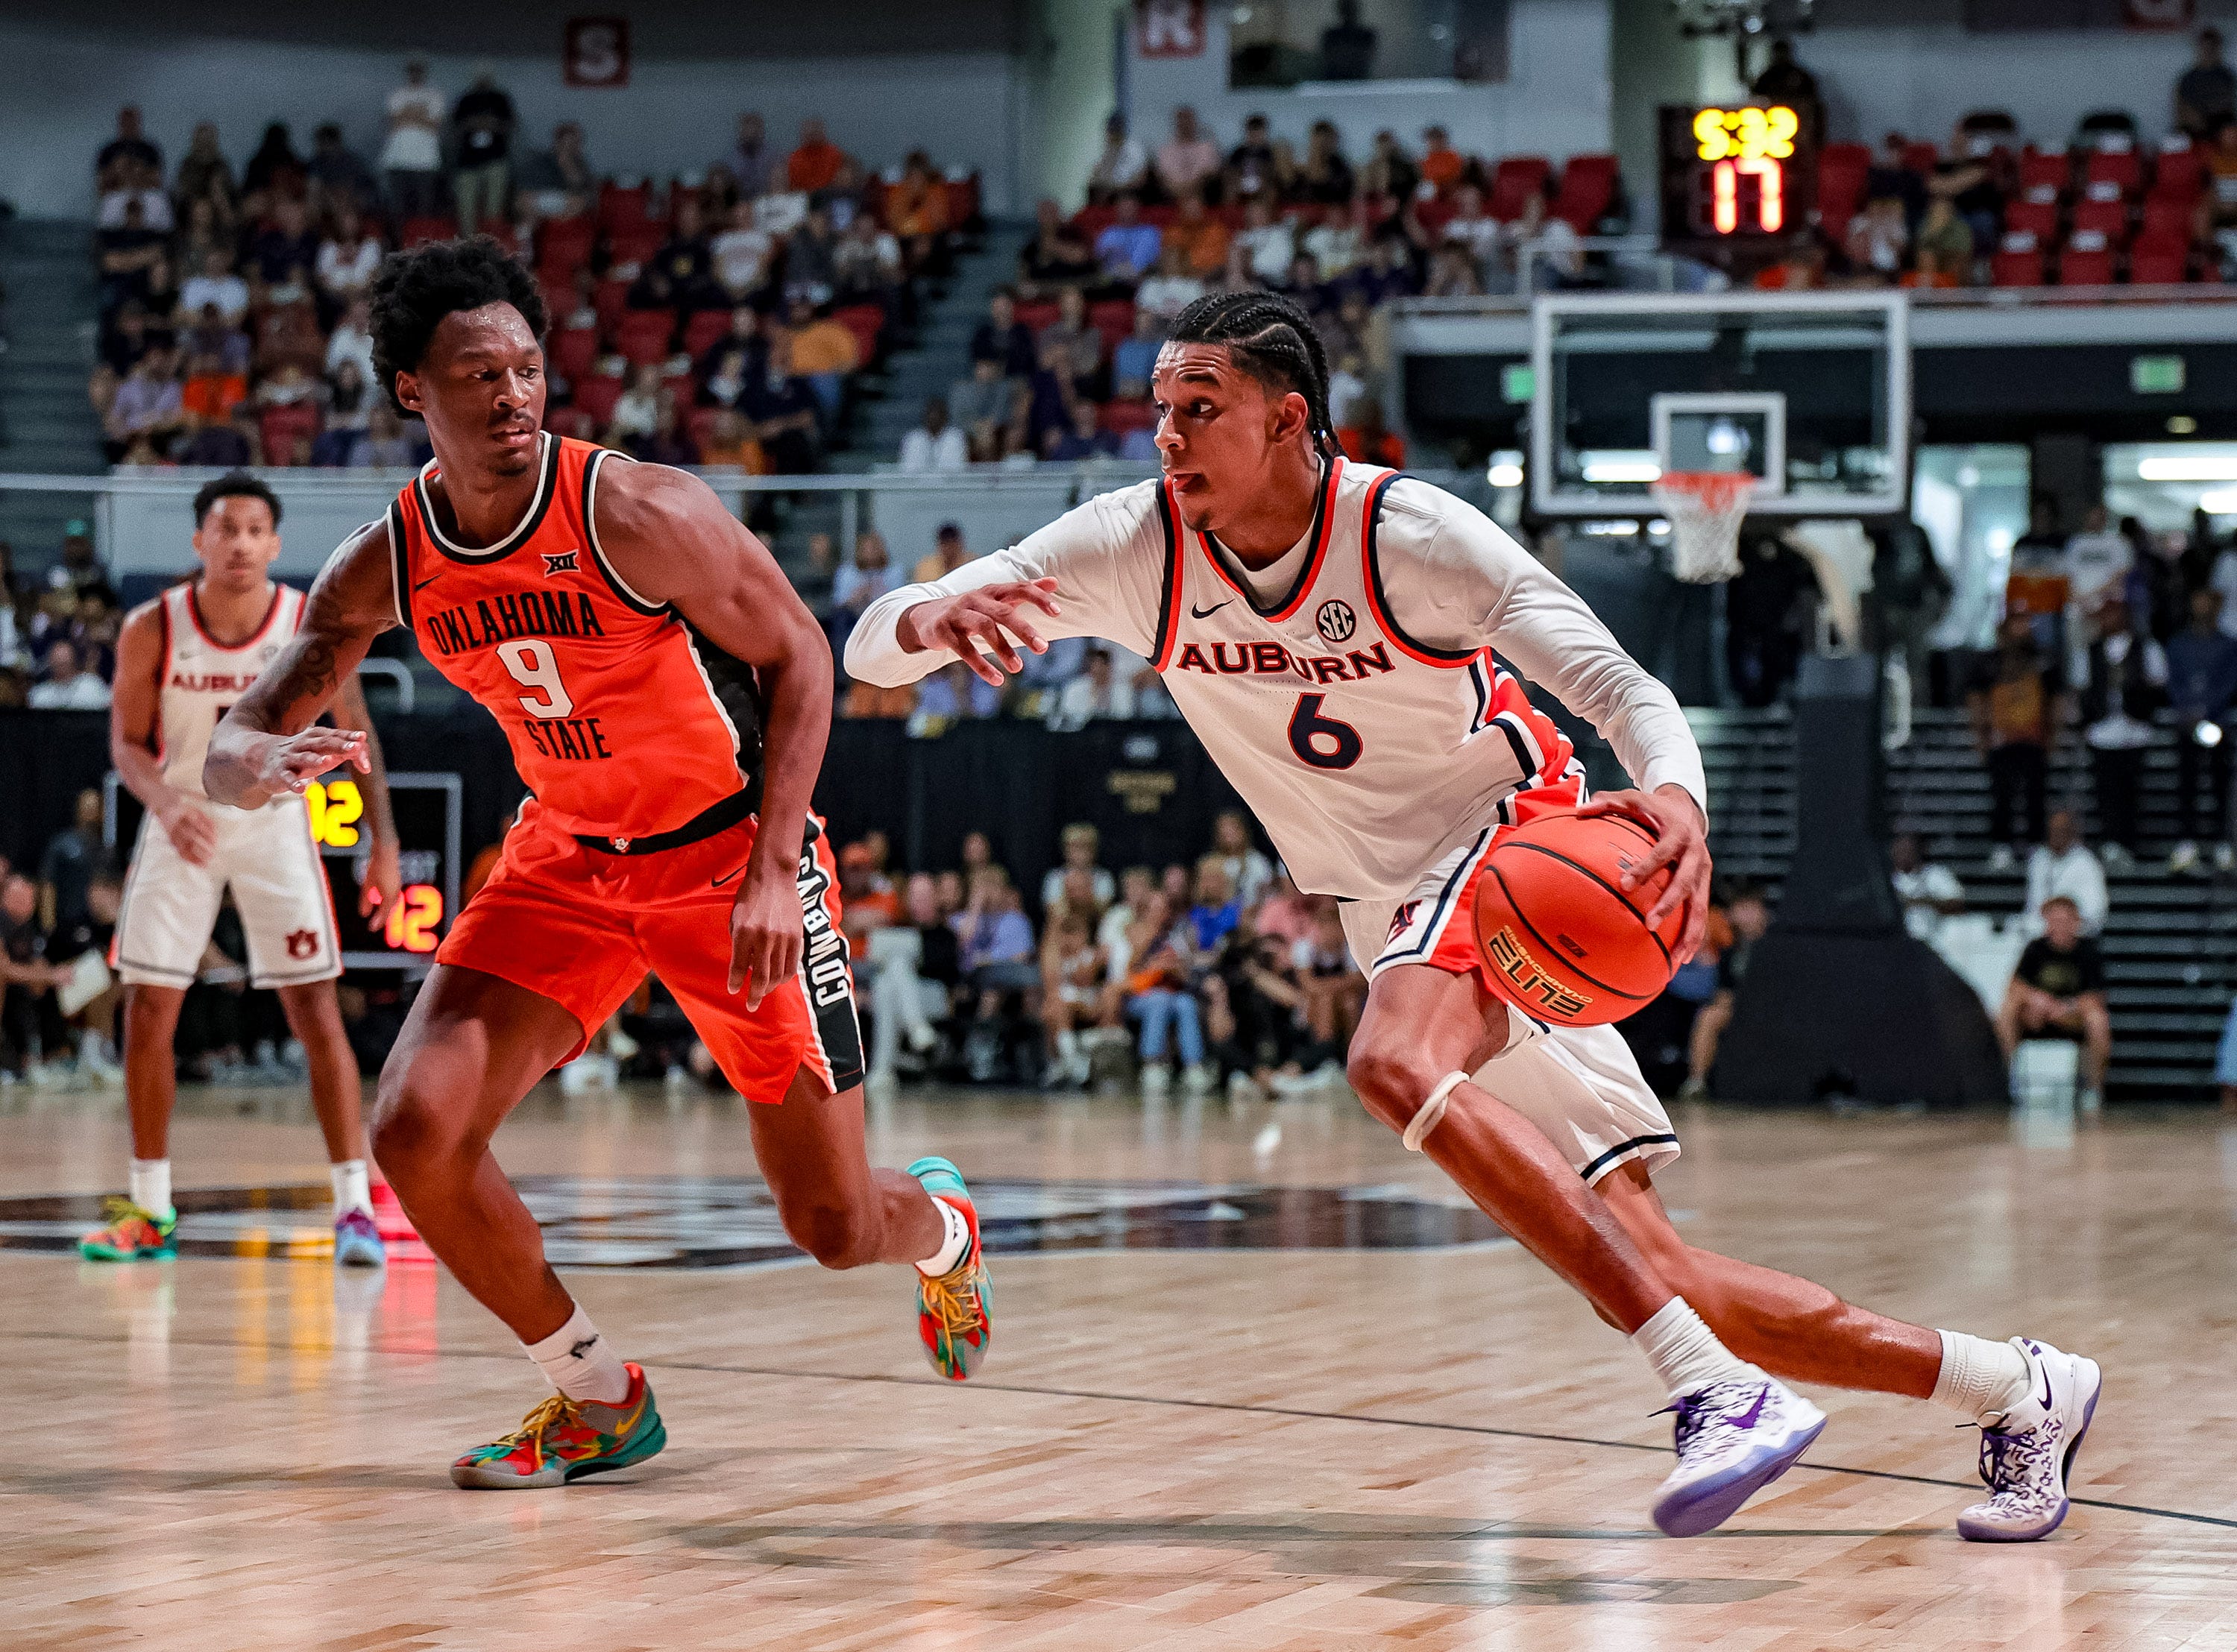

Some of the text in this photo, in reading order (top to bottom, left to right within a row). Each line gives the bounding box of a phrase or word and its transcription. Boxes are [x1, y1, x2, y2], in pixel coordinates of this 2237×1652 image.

[1714, 157, 1783, 234] 17
[541, 549, 582, 578] XII
[427, 590, 605, 656] OKLAHOMA
[1318, 602, 1354, 641] SEC
[172, 673, 258, 693] AUBU
[495, 638, 576, 720] 9
[1176, 640, 1397, 685] AUBURN
[523, 718, 612, 760] STATE
[1287, 692, 1365, 771] 6
[1488, 930, 1587, 1018] ELITE
